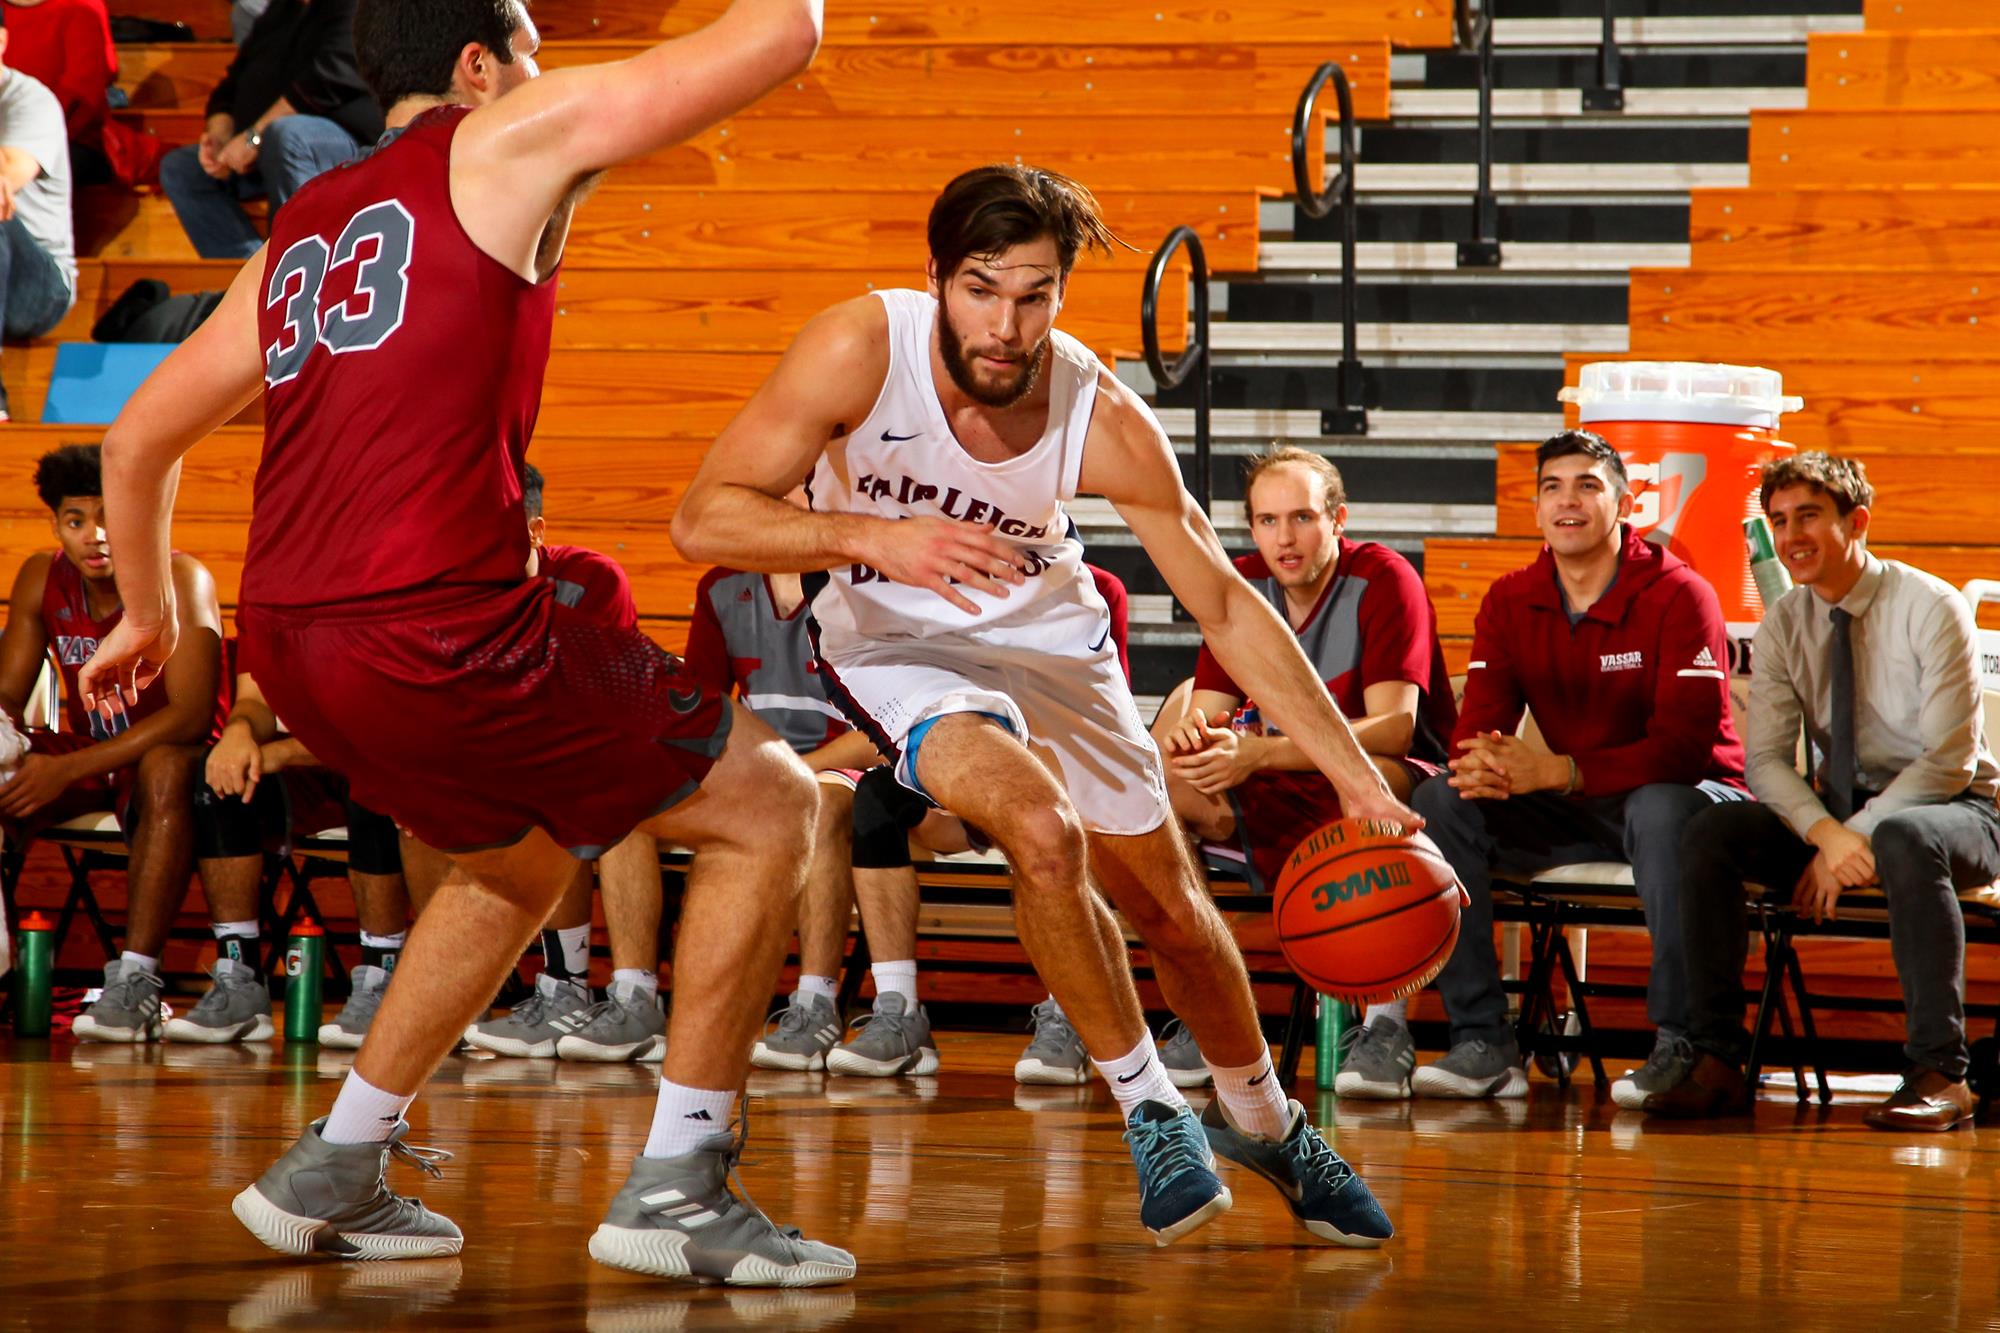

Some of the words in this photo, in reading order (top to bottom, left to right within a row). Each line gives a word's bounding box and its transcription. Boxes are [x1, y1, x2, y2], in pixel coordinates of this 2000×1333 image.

[264, 198, 415, 390] 33
[1600, 651, 1642, 667] VASSAR
[1311, 865, 1392, 912] MAC
